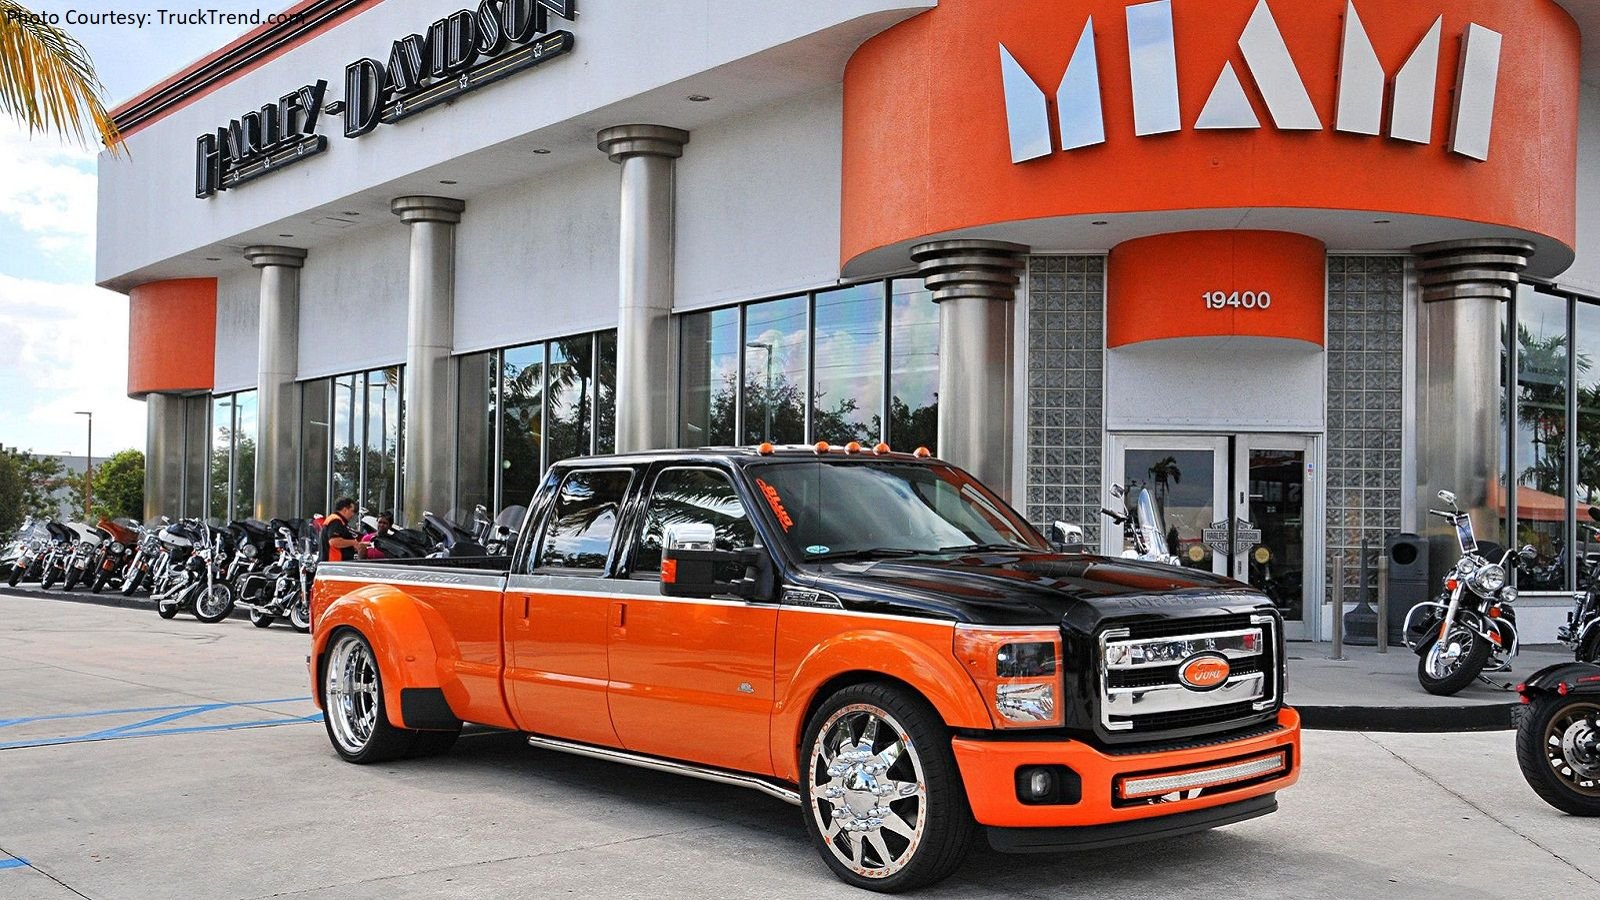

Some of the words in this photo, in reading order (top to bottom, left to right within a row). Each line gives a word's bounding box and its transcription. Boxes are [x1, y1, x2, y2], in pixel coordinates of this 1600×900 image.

[999, 0, 1502, 163] MIAMI
[1202, 291, 1271, 309] 19400
[1206, 532, 1258, 540] HARLEY-AVIDSON
[1194, 661, 1222, 680] Ford
